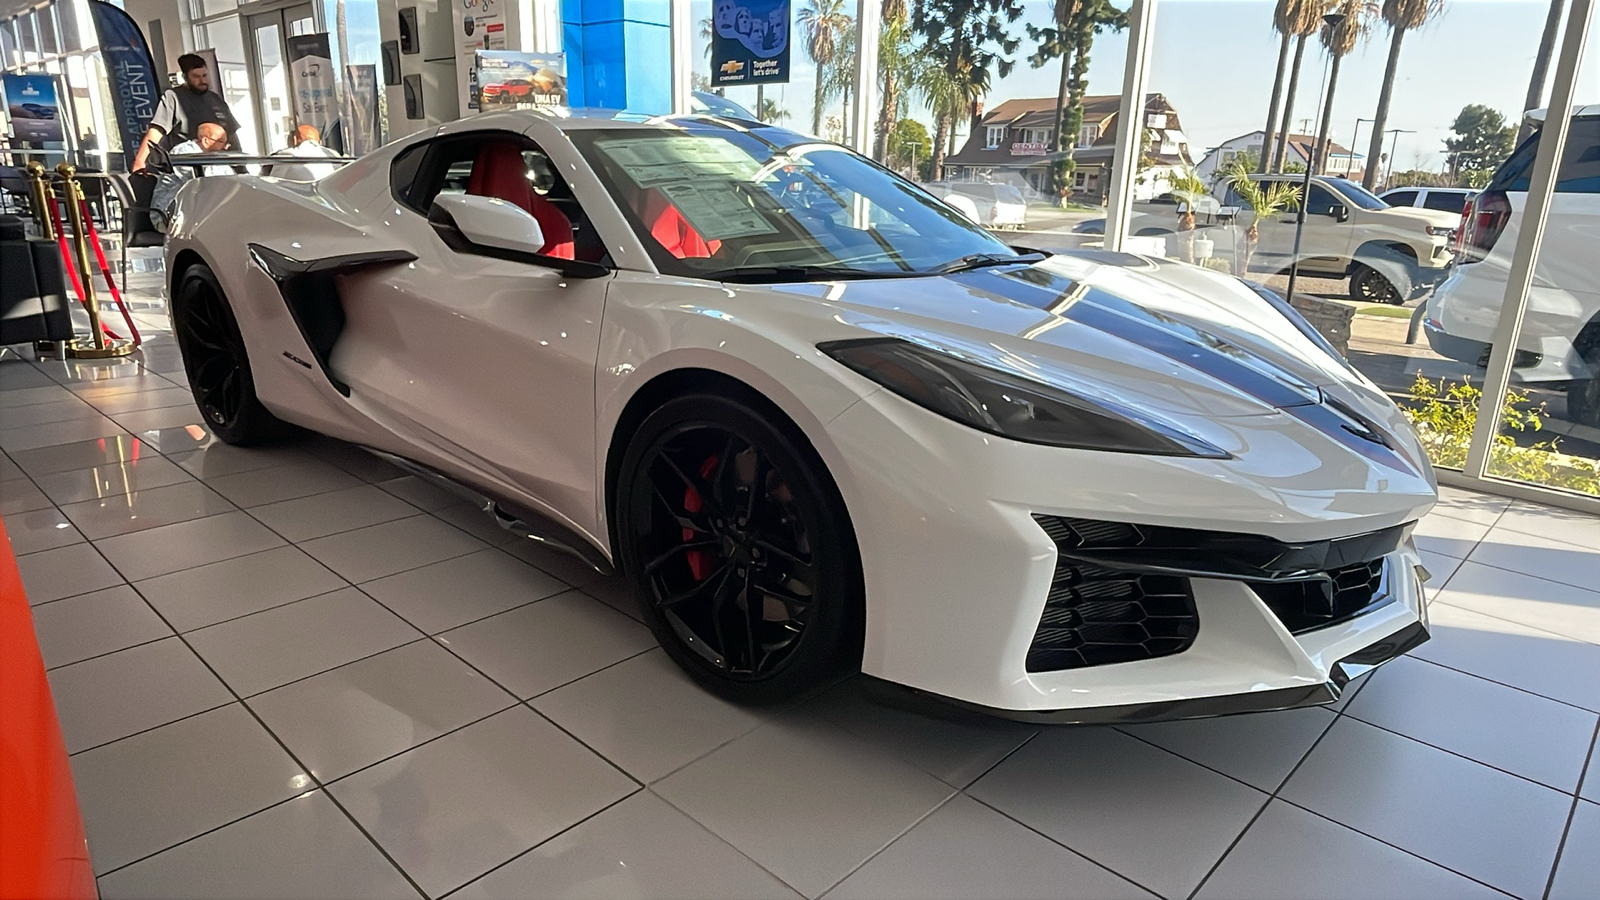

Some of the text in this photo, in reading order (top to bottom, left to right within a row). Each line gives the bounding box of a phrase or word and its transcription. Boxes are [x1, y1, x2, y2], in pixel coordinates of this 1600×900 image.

[754, 61, 777, 69] Together
[124, 61, 154, 119] EVENT
[114, 61, 142, 157] E-APPROVAL
[1012, 142, 1048, 150] DENTIST
